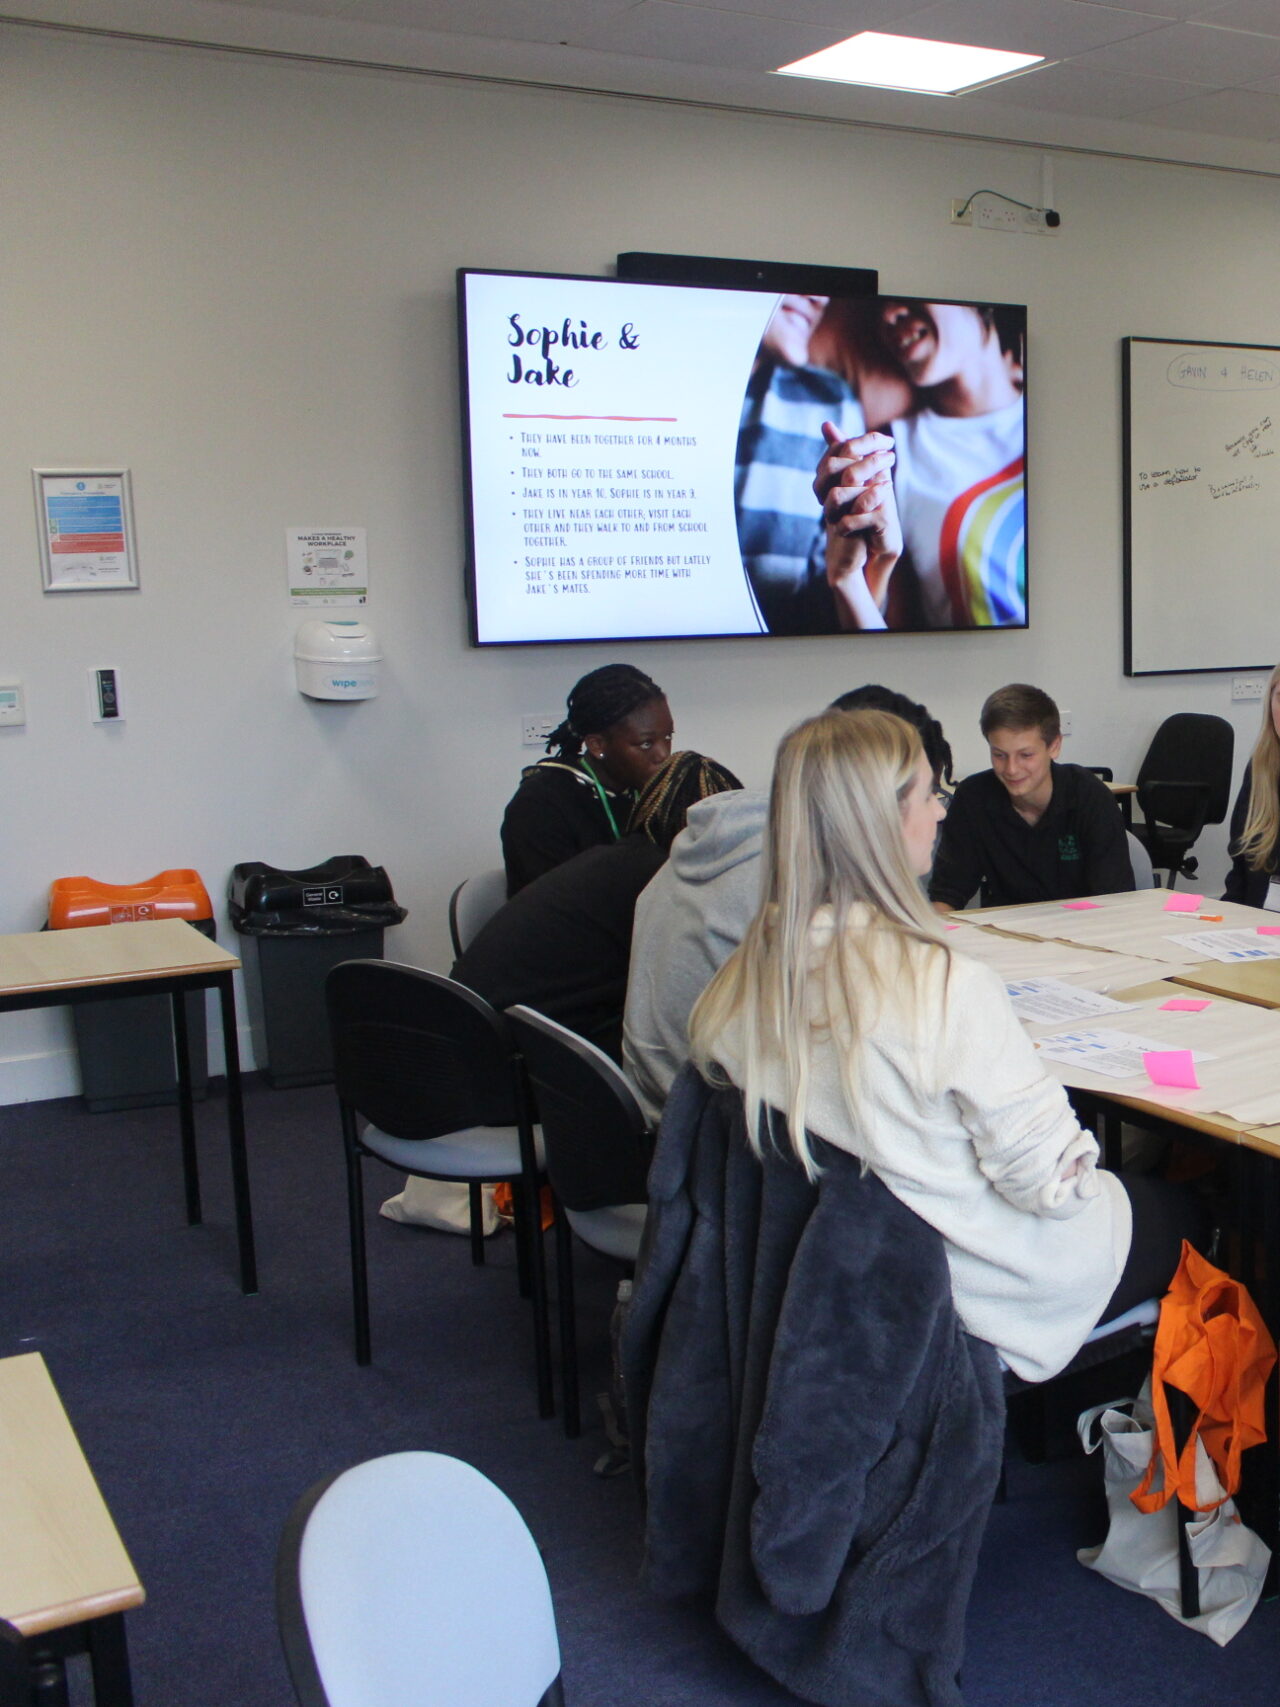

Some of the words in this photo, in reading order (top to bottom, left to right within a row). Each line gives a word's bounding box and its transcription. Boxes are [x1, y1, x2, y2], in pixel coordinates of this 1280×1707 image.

[508, 313, 608, 359] Sophie
[619, 322, 640, 350] &
[507, 353, 579, 388] Jake
[521, 432, 541, 443] THEY
[546, 433, 566, 444] HAVE
[571, 434, 591, 444] BEEN
[595, 434, 634, 446] TOGETHER
[638, 435, 653, 445] FOR
[664, 436, 697, 447] MONTHS
[522, 466, 543, 478] THEY
[547, 468, 568, 479] BOTH
[571, 468, 582, 479] GO
[585, 468, 596, 479] TO
[598, 468, 614, 479] THE
[616, 469, 638, 479] SAME
[522, 487, 543, 498] JAKE
[546, 488, 556, 498] IS
[558, 488, 568, 498] IN
[571, 488, 593, 498] YEAR
[610, 487, 640, 499] SOPHIE
[643, 489, 652, 499] IS
[654, 489, 664, 499] IN
[667, 489, 687, 499] YEAR
[523, 508, 544, 519] THEY
[547, 508, 565, 519] LIVE
[569, 508, 591, 519] NEAR
[594, 508, 615, 519] EACH
[648, 508, 669, 519] VISIT
[672, 508, 692, 518] EACH
[523, 523, 551, 533] OTHER
[554, 523, 571, 533] AND
[573, 522, 594, 533] THEY
[596, 522, 618, 533] WALK
[621, 522, 631, 532] TO
[634, 522, 650, 532] AND
[653, 522, 675, 532] FROM
[678, 522, 708, 532] SCHOOL
[525, 556, 556, 567] SOPHIE
[559, 556, 576, 567] HAS
[579, 556, 584, 566] A
[587, 556, 614, 566] GROUP
[616, 556, 627, 566] OF
[630, 556, 664, 565] FRIENDS
[667, 556, 681, 565] BUT
[683, 555, 711, 565] LATELY
[557, 570, 578, 580] BEEN
[581, 570, 621, 580] SPENDING
[624, 569, 647, 579] MORE
[650, 569, 670, 579] TIME
[672, 568, 691, 578] WITH
